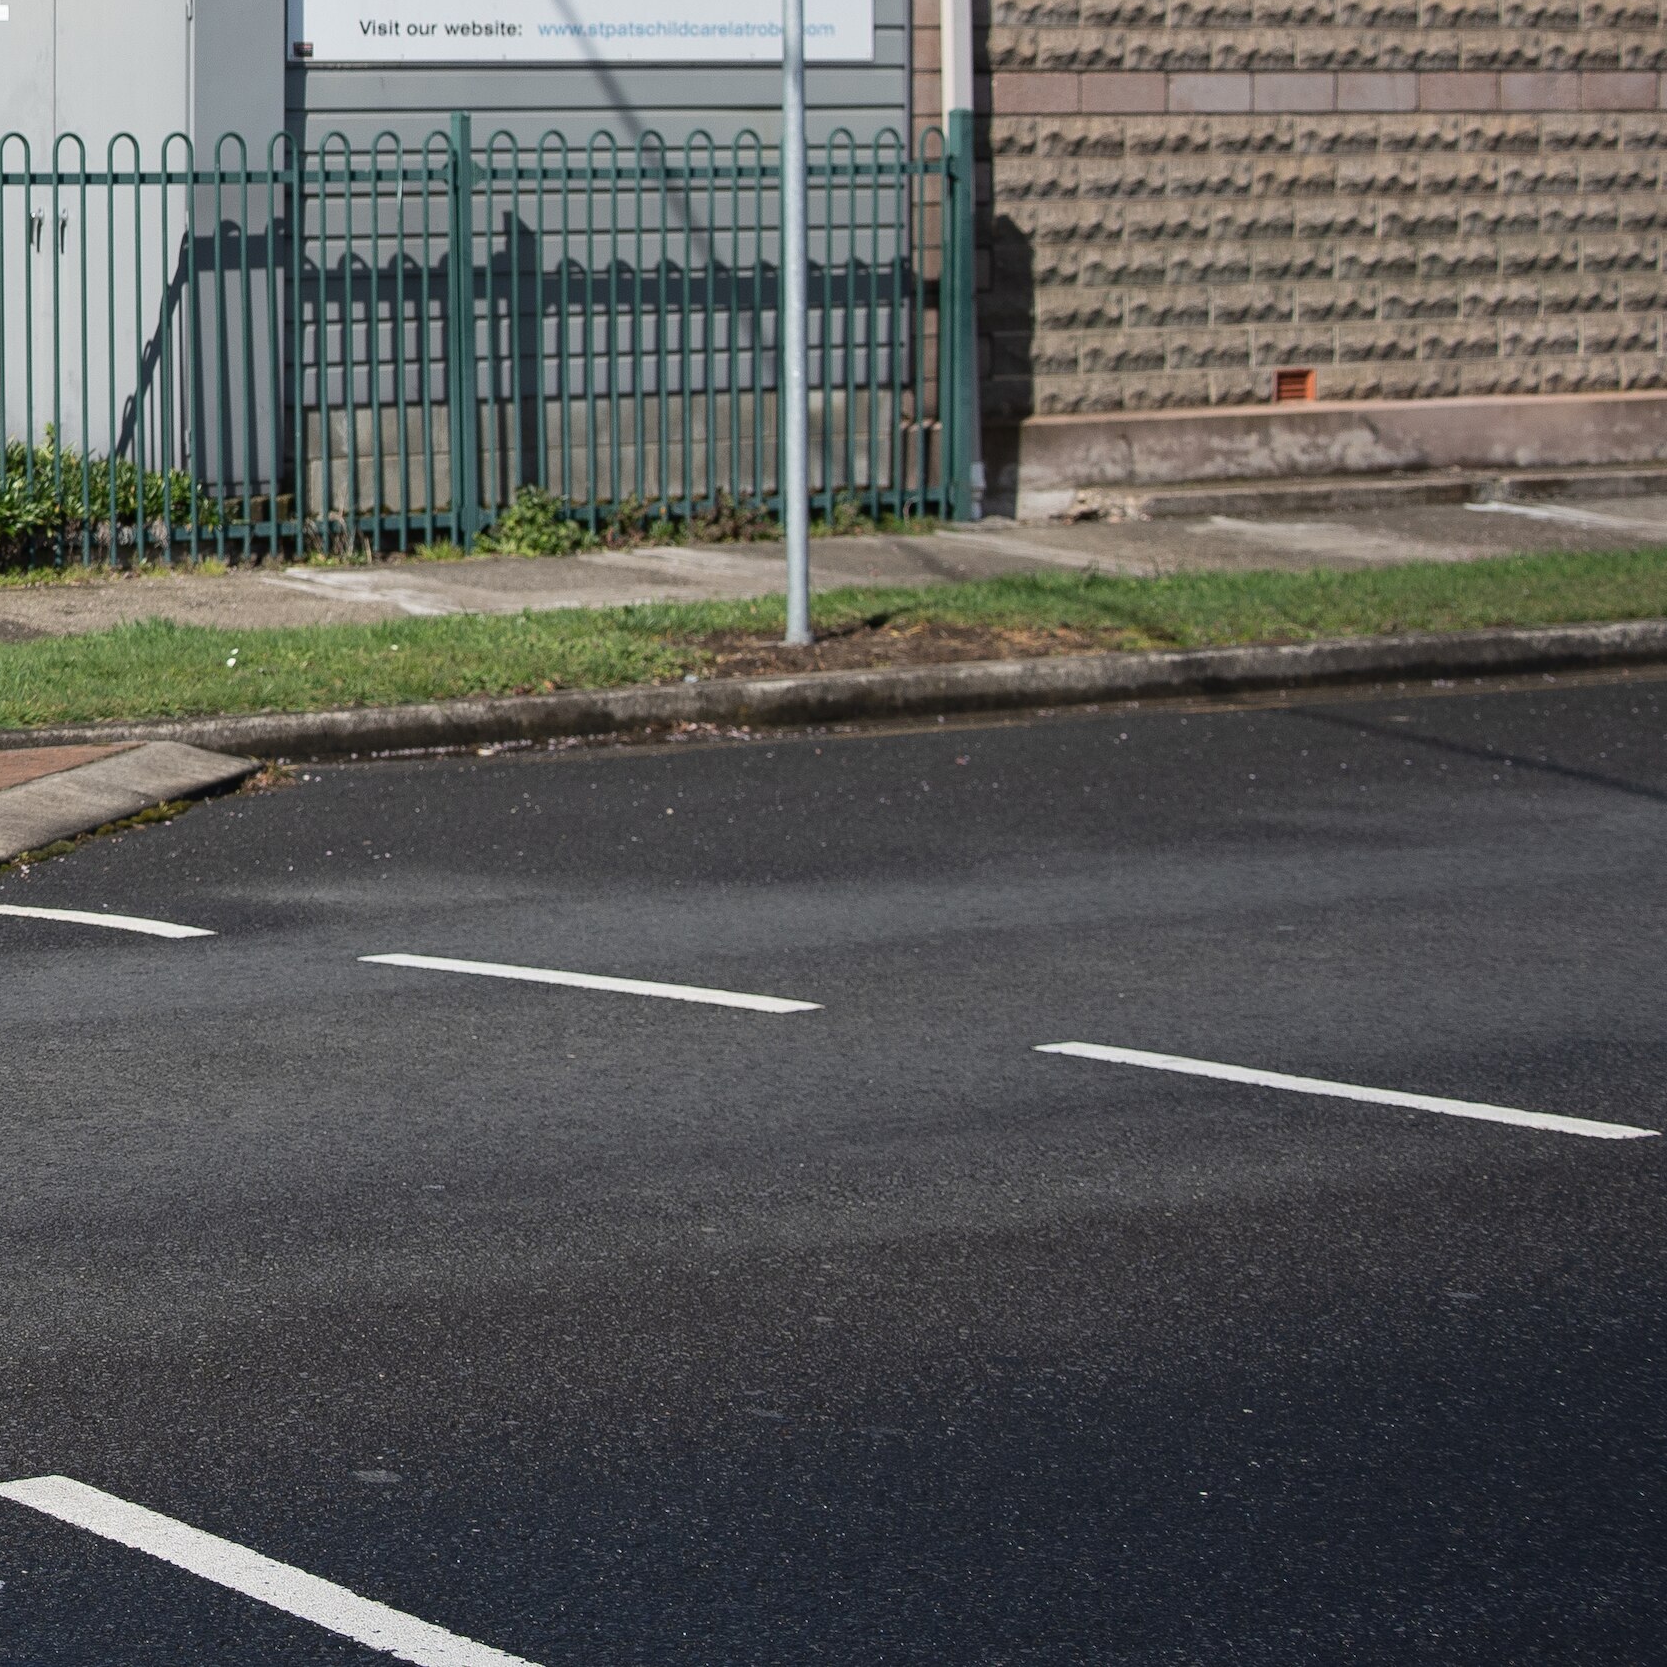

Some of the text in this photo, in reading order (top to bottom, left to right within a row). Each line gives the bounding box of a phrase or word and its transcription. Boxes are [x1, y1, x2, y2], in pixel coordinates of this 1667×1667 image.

[359, 19, 400, 36] Visit
[407, 24, 437, 36] our
[444, 20, 523, 37] website:
